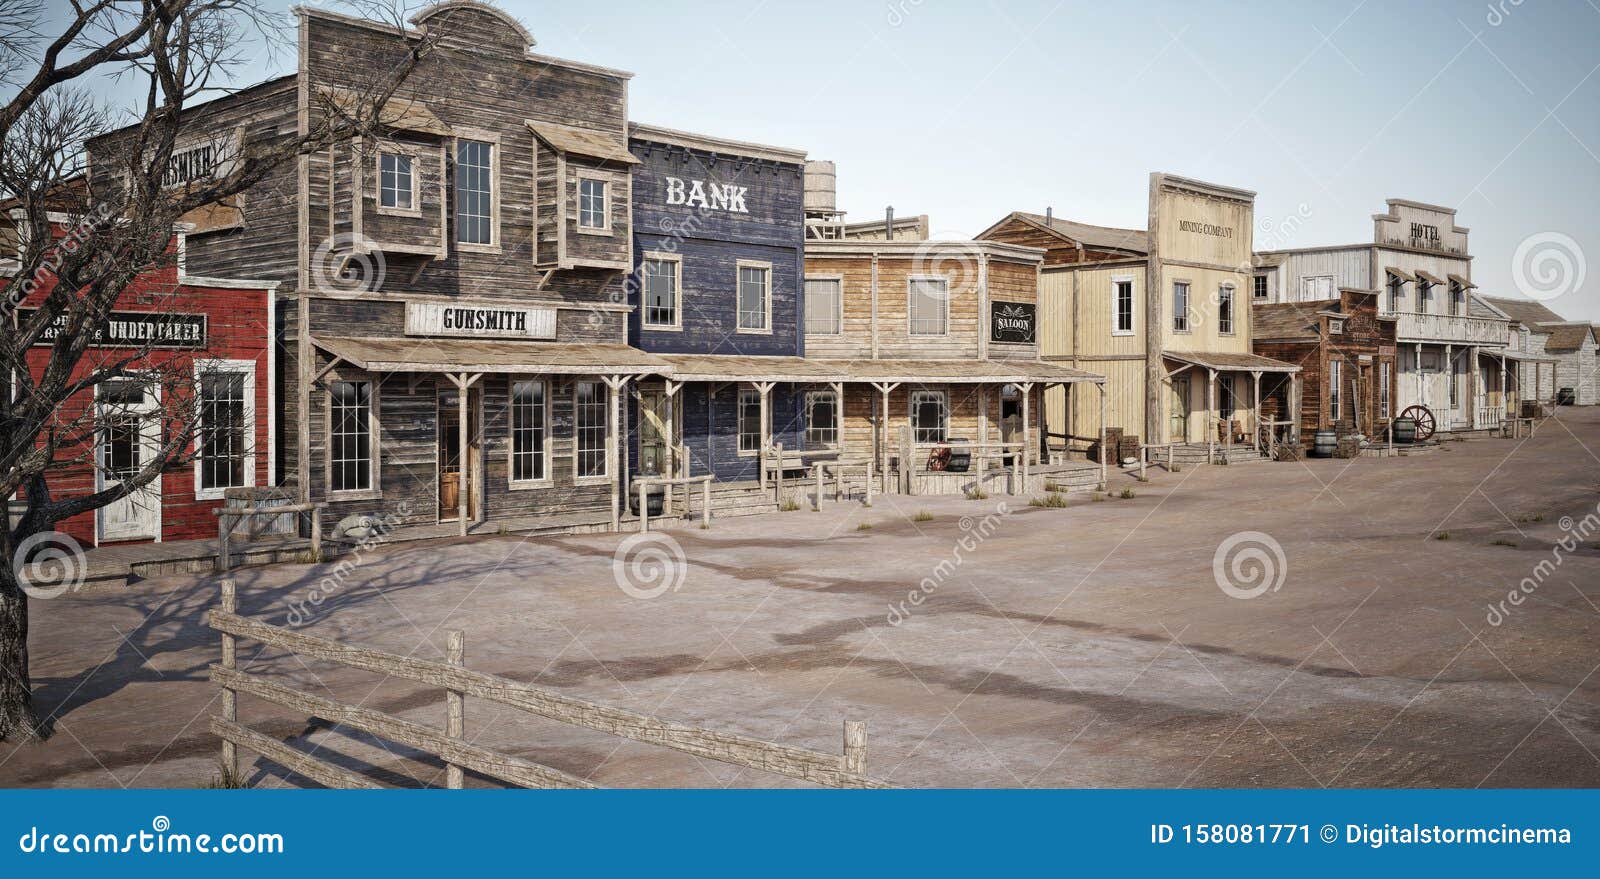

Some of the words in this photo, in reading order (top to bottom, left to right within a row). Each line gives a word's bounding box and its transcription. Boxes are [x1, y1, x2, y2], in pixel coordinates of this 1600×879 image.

[665, 176, 749, 213] BANK
[1179, 220, 1203, 234] MINING
[1203, 223, 1233, 239] COMPANY
[1410, 222, 1440, 241] HOTEL
[443, 308, 527, 331] GUNSMITH
[998, 317, 1029, 331] SALOON
[108, 321, 200, 340] UNDERTAKER
